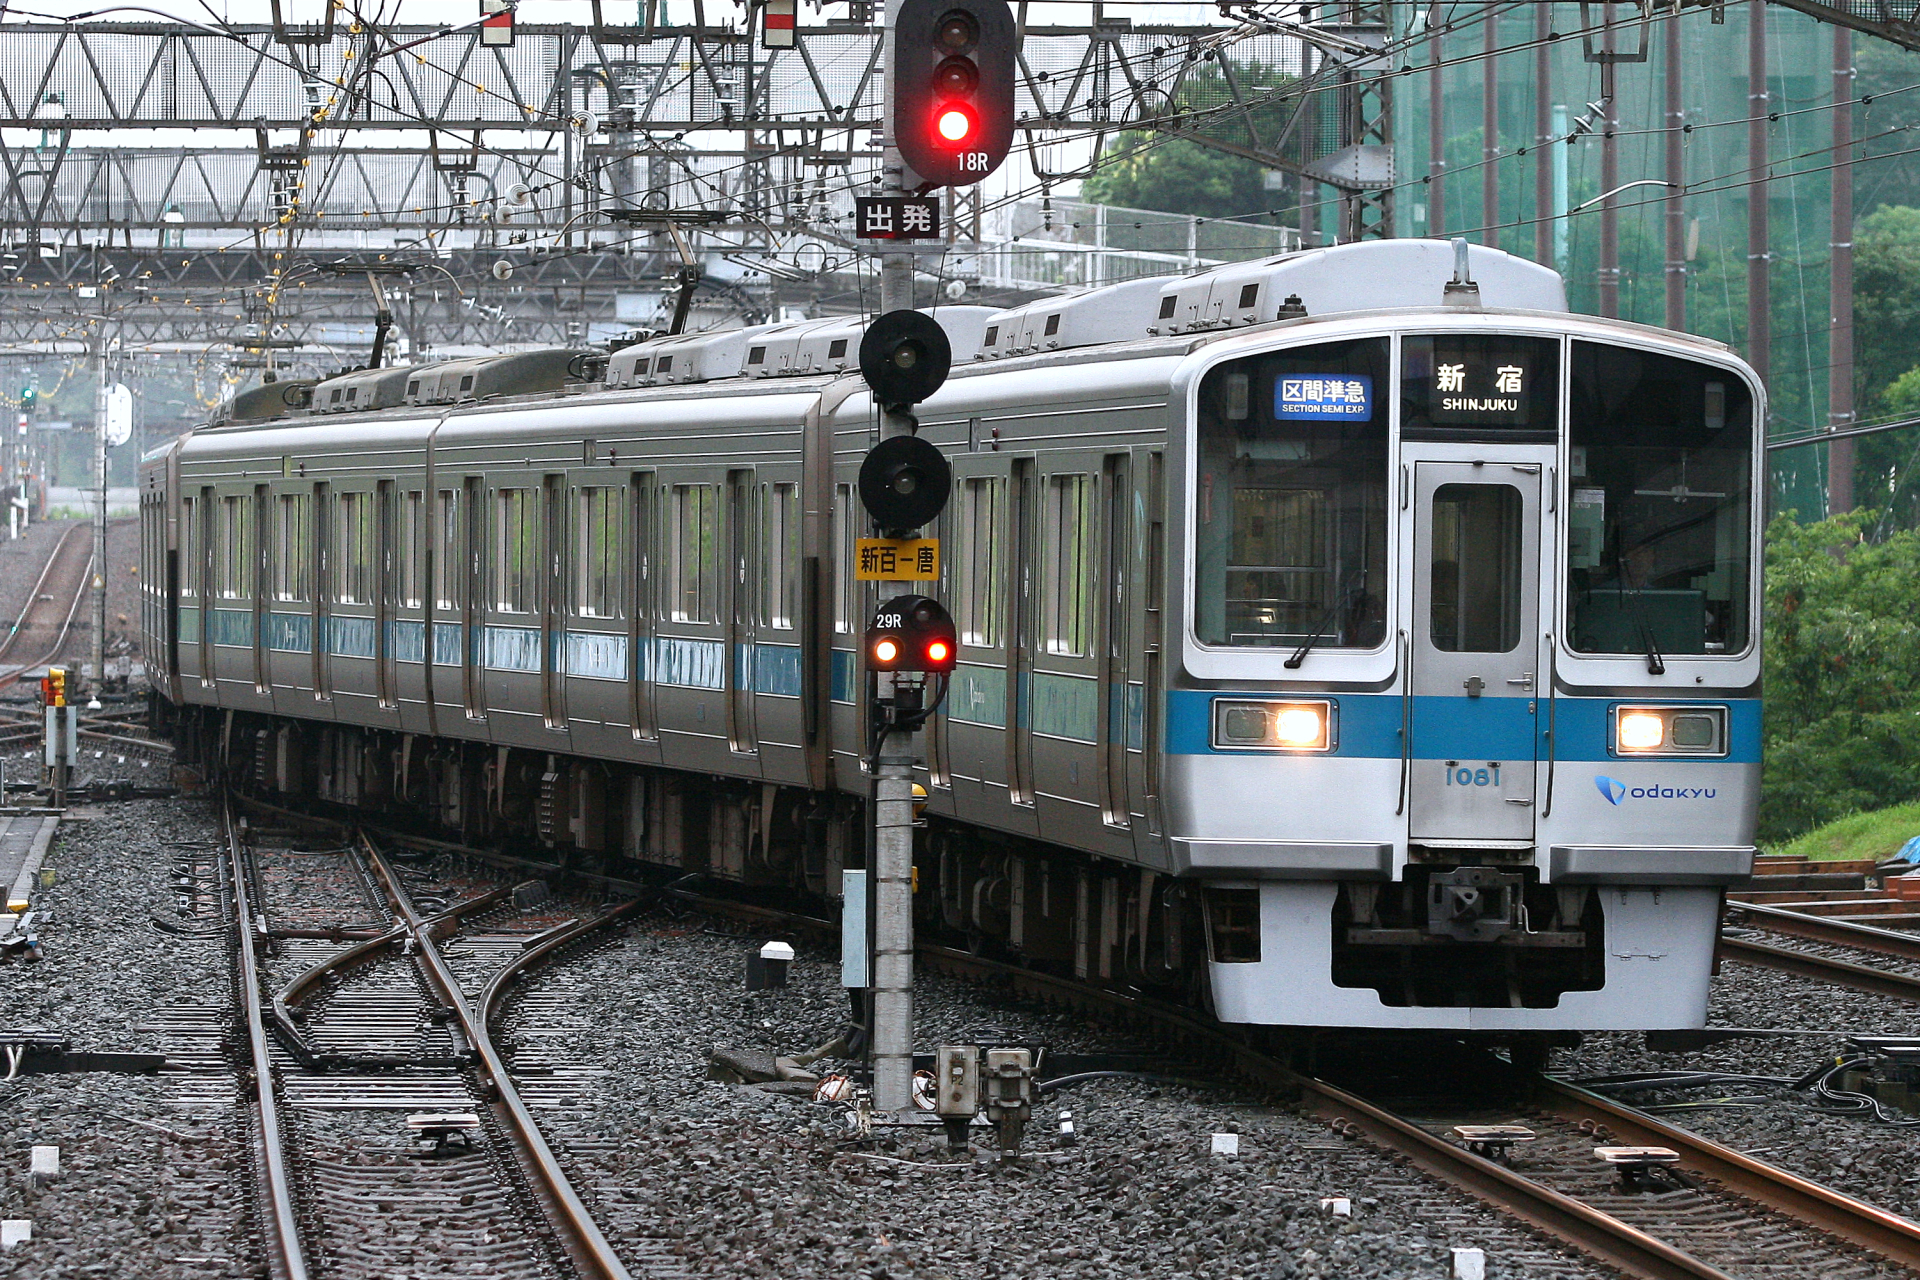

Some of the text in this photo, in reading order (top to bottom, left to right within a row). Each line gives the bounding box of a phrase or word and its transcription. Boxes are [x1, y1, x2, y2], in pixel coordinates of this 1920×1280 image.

[957, 152, 989, 171] 18R
[866, 204, 931, 232] 出発
[1436, 363, 1523, 393] 新宿
[1282, 379, 1366, 403] 区間準急
[1282, 404, 1365, 414] SECTION SEMI EXP.
[1442, 398, 1518, 411] SHINJUKU
[876, 614, 902, 628] 29R
[1446, 767, 1500, 786] 1081
[1631, 784, 1716, 799] odakyu
[951, 1075, 963, 1085] P2
